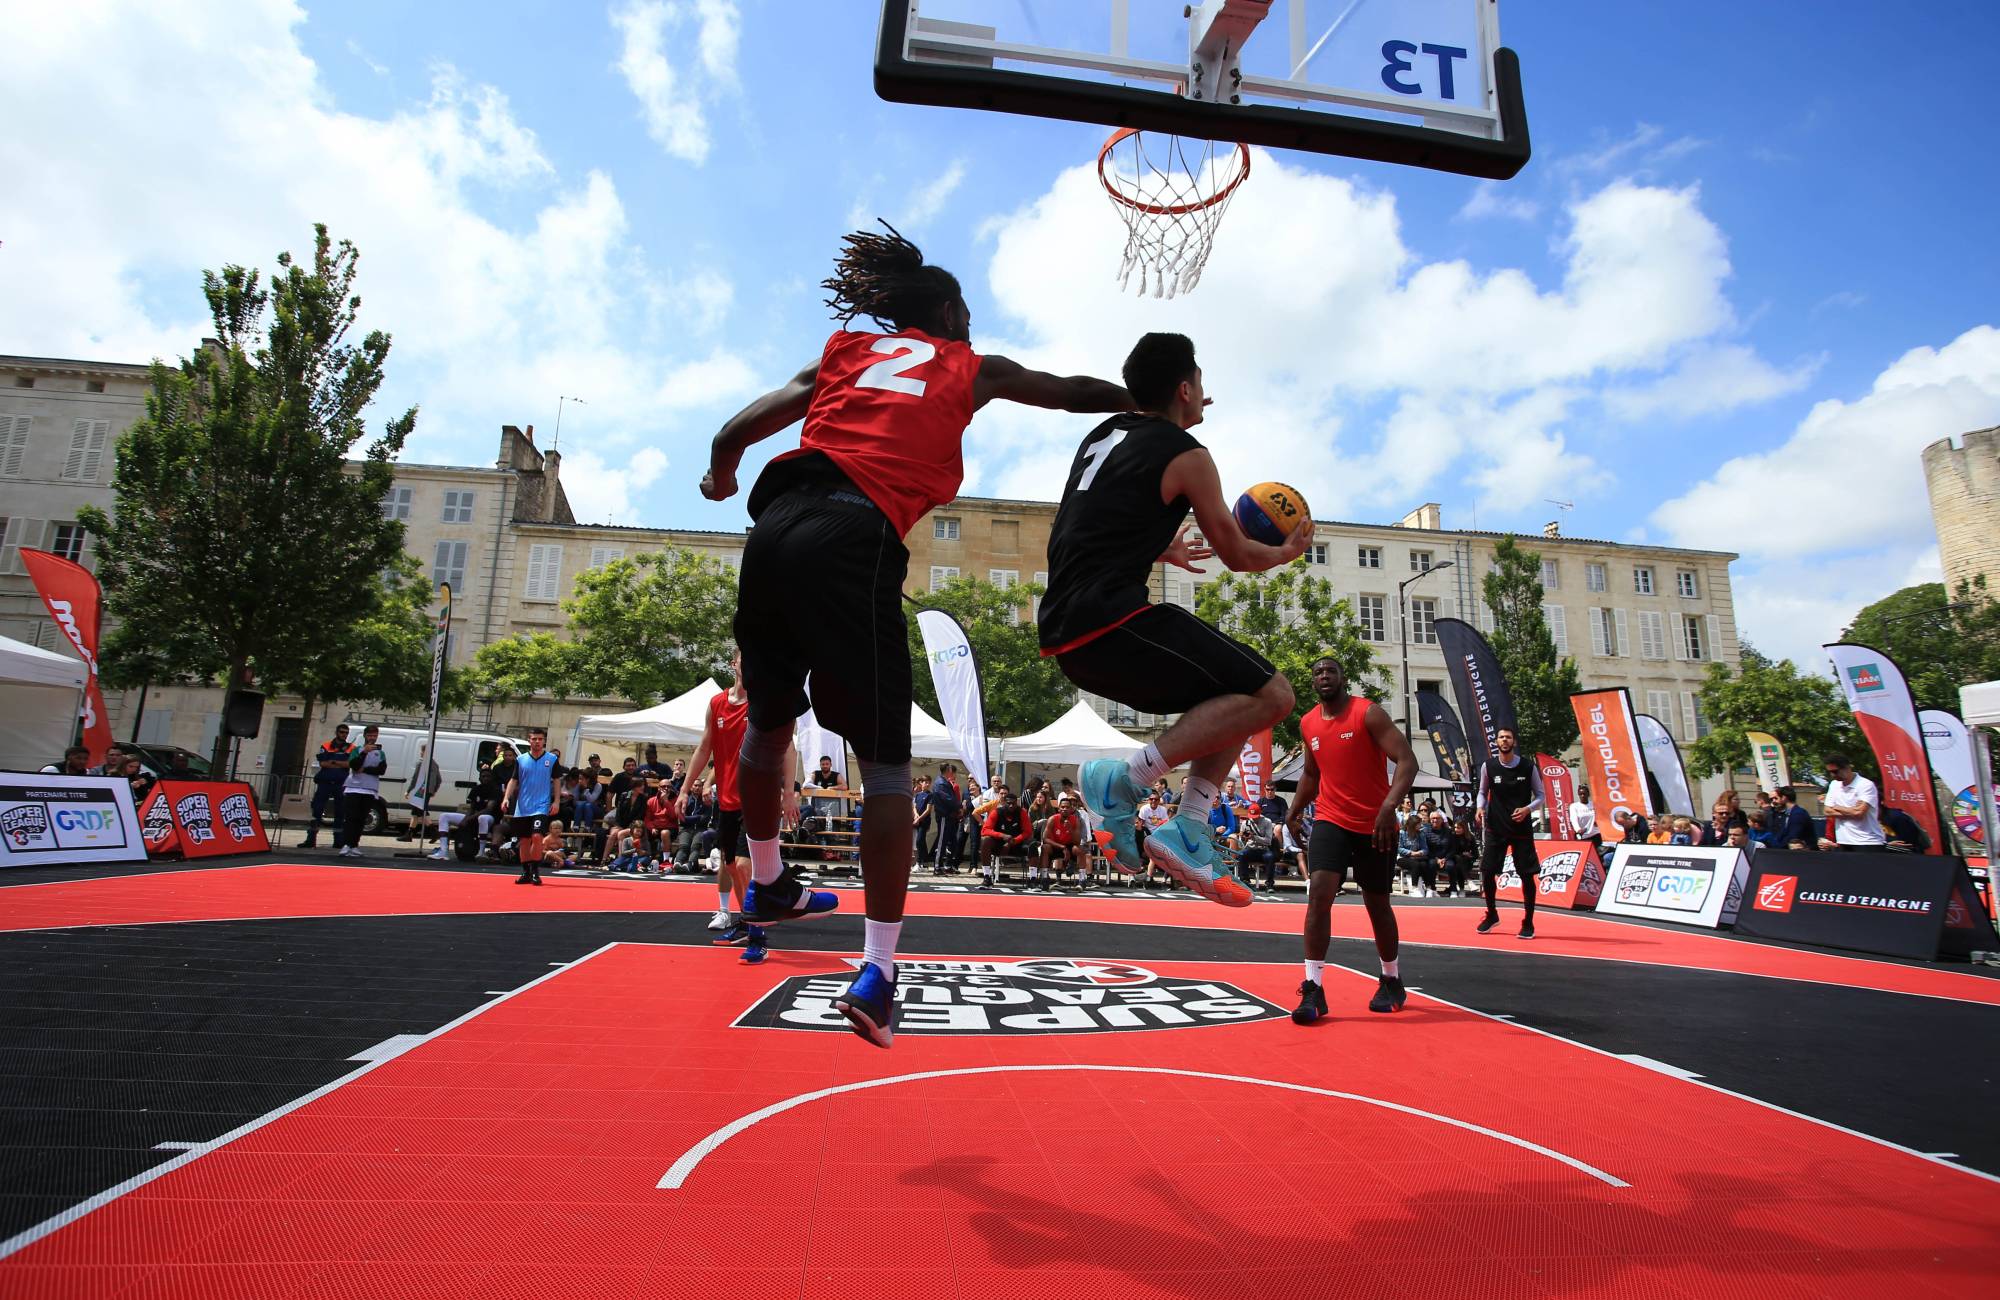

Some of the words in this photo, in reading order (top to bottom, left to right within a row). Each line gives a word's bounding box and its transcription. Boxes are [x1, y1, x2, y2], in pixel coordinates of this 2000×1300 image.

[854, 337, 936, 397] 2
[25, 791, 68, 799] PARTENAIRE
[176, 795, 209, 816] SUPER
[219, 795, 248, 816] SUPER
[2, 806, 43, 824] SUPER
[56, 810, 114, 831] GRDF
[180, 808, 212, 826] LEAGUE
[222, 808, 252, 824] LEAGUE
[4, 818, 46, 831] LEAGUE
[1541, 852, 1580, 868] SUPER
[1539, 864, 1575, 878] LEAGUE
[1622, 871, 1652, 882] SUPER
[1621, 880, 1651, 888] LEAGUE
[1657, 875, 1708, 895] GRDF
[1799, 891, 1843, 904] CAISSE
[1848, 894, 1932, 911] D'EPARGNE
[795, 979, 1242, 1005] LEAGUE
[780, 997, 1266, 1030] SUPER
